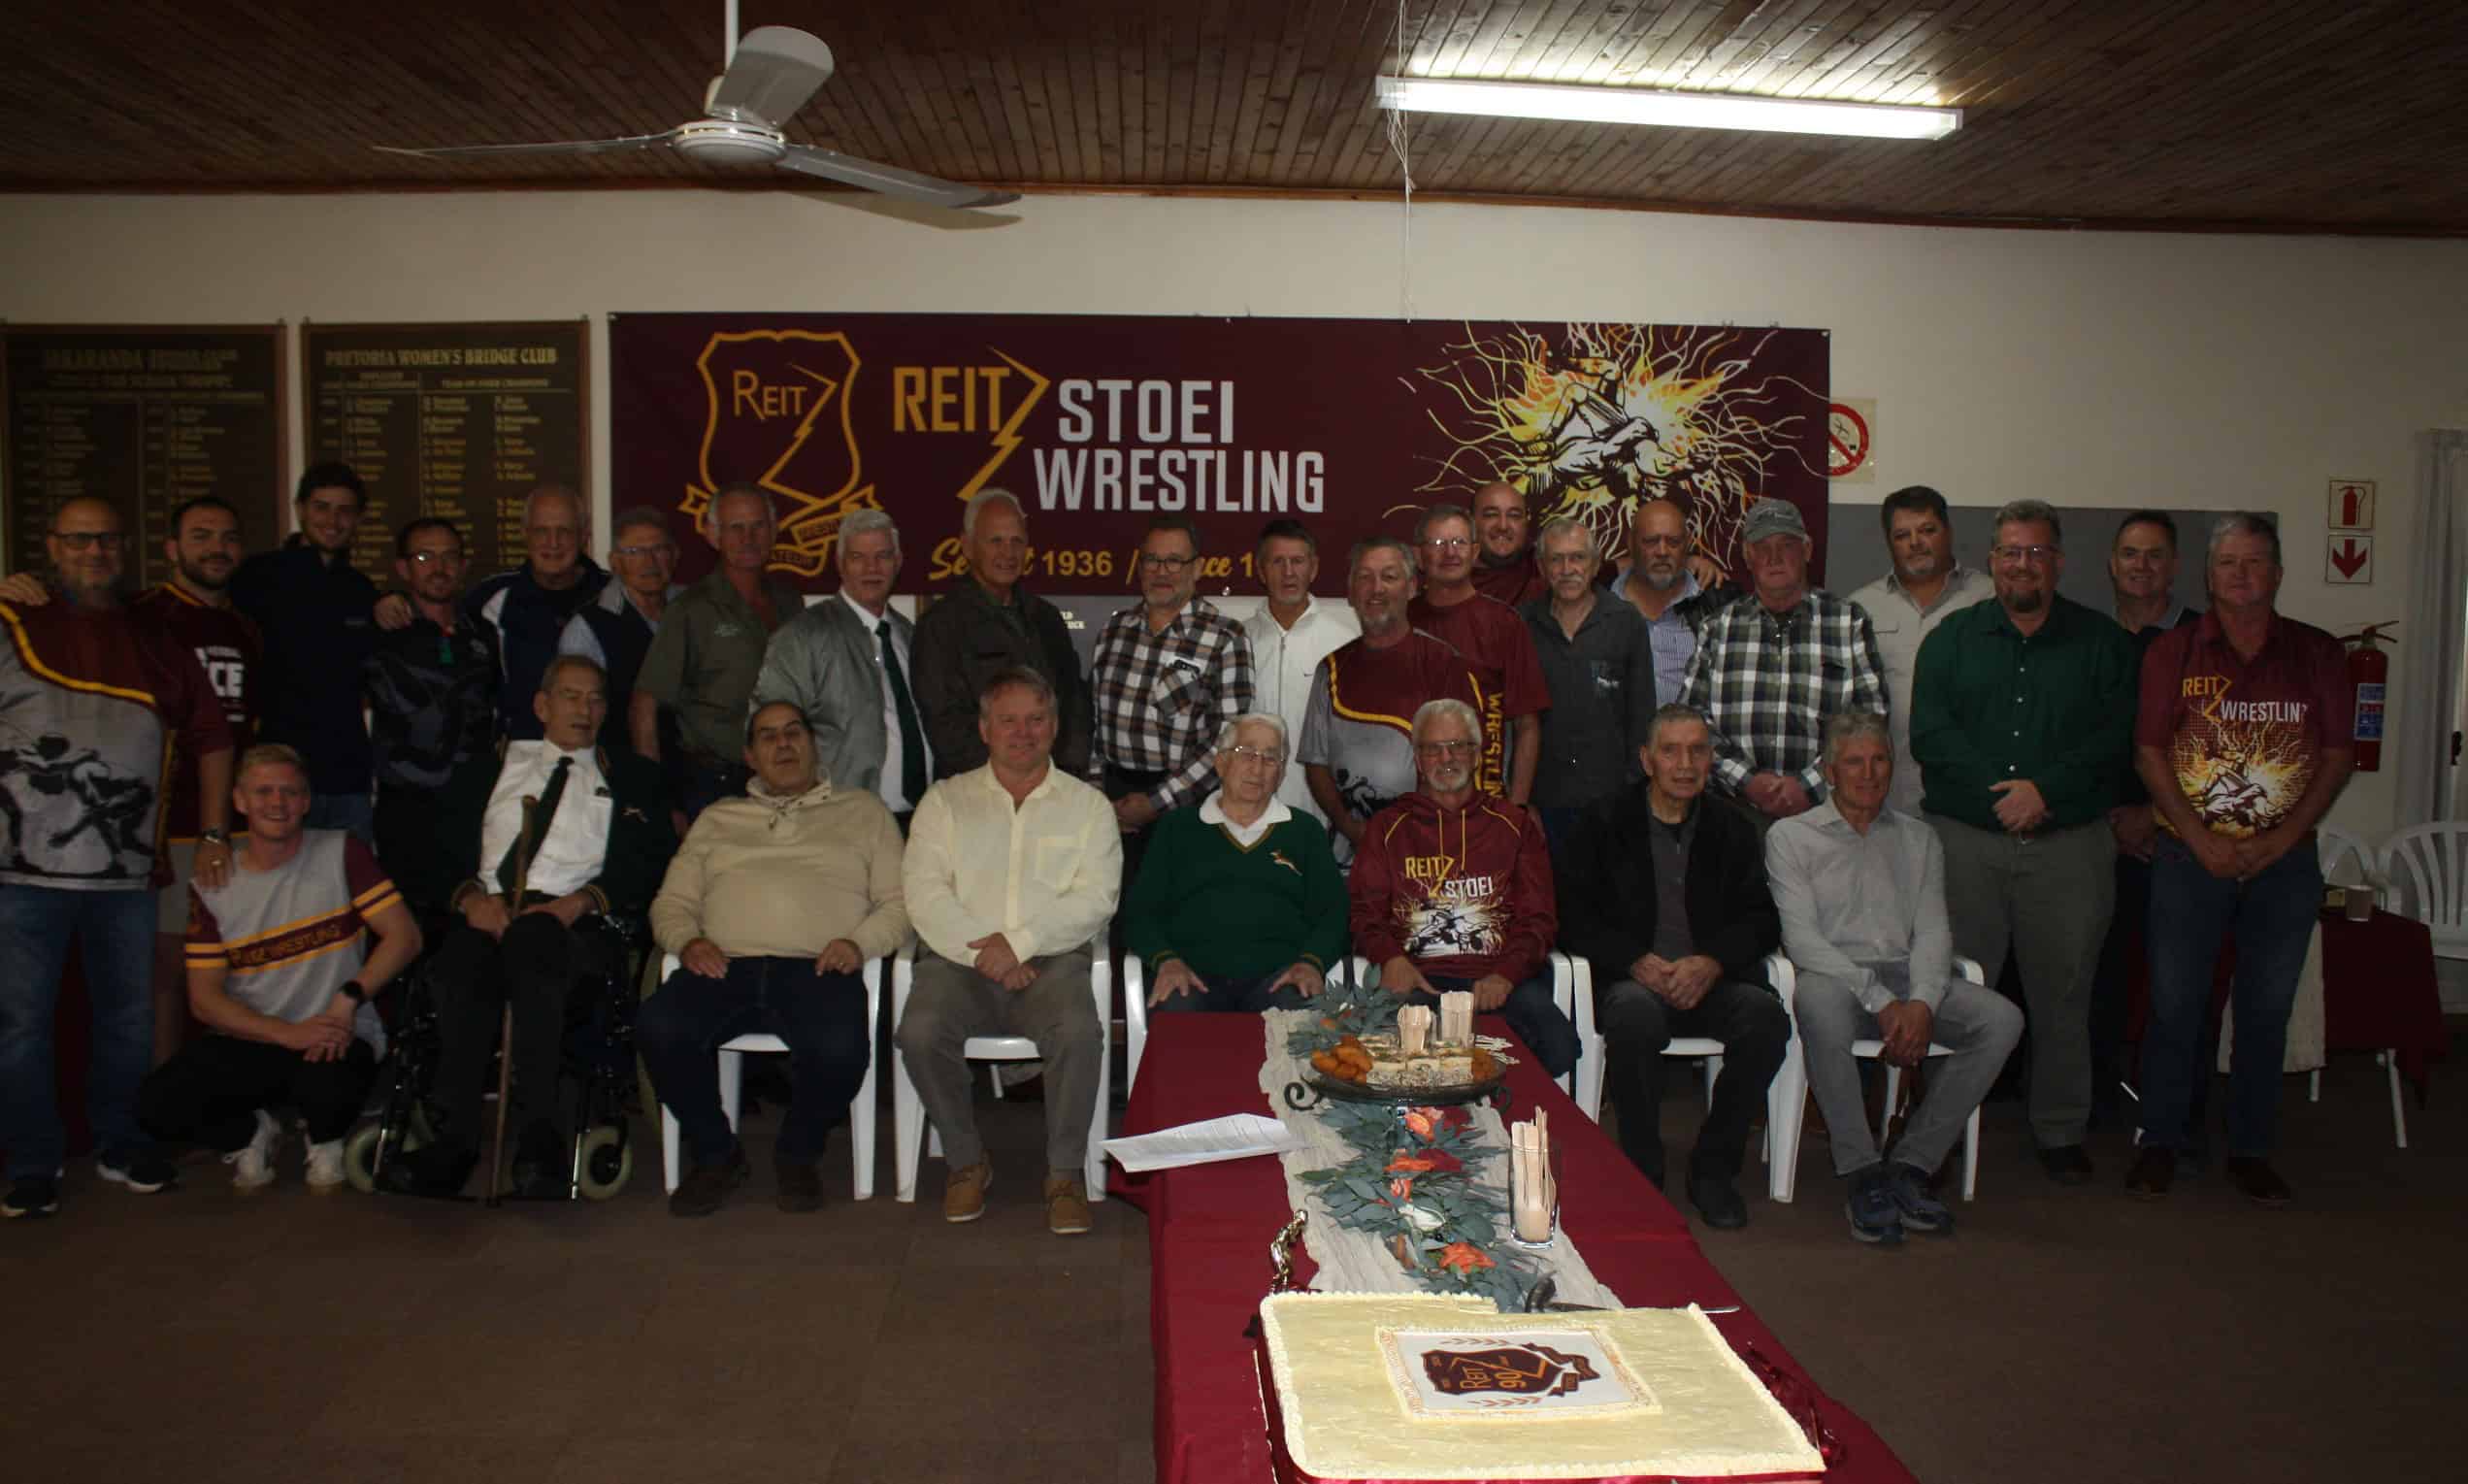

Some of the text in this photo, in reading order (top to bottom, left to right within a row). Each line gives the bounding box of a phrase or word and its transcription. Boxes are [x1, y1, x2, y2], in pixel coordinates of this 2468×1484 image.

[324, 346, 558, 366] PRETORIA WOMEN'S BRIDGE CLUB
[1058, 379, 1234, 444] STOEI
[1033, 448, 1325, 512] WRESTLING
[1040, 548, 1113, 578] 1936
[1482, 690, 1507, 798] WRESTLIN
